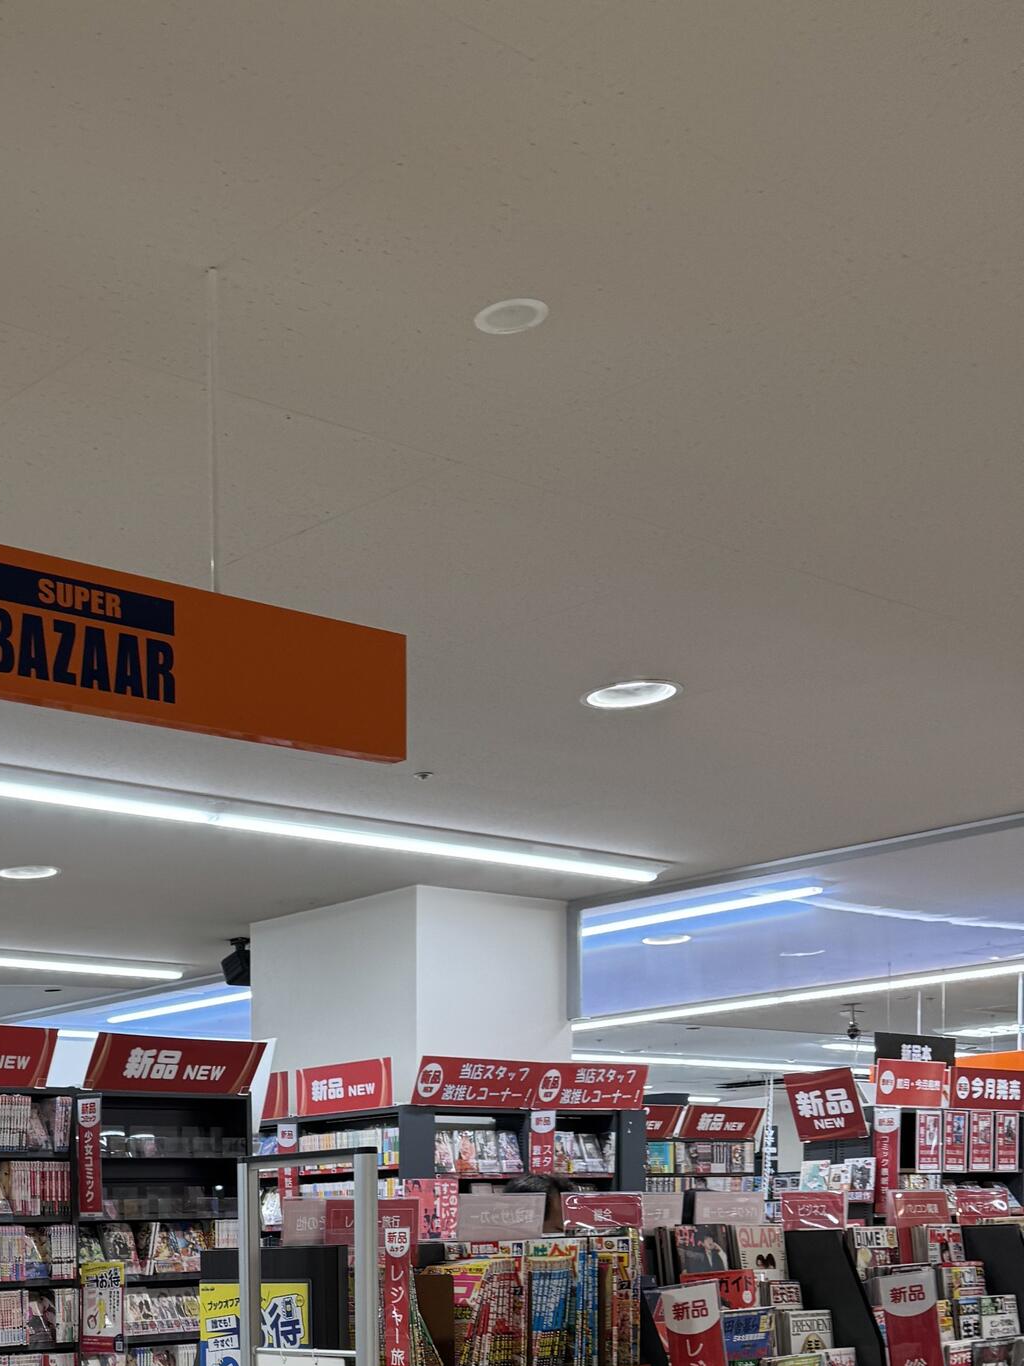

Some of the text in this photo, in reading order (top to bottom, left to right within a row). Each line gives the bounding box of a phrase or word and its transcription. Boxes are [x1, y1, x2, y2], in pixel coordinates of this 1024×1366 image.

[37, 577, 124, 619] SUPER
[123, 1047, 227, 1081] 新品 NEW
[459, 1064, 531, 1082] 当店スタッフ
[575, 1068, 638, 1084] 当店スタッフ
[311, 1077, 376, 1102] 新品 NEW
[971, 1077, 1021, 1101] 今月発売
[81, 1102, 96, 1115] 新品
[795, 1088, 855, 1118] 新品
[696, 1113, 745, 1131] 新品 NEW
[813, 1117, 845, 1130] NEW
[84, 1130, 94, 1203] 少女コミック
[797, 1203, 829, 1216] ビジネス
[387, 1231, 408, 1244] 新品
[855, 1231, 881, 1247] DIME
[890, 1284, 925, 1304] 新品
[672, 1298, 709, 1322] 新品
[213, 1337, 233, 1348] 今すぐ!
